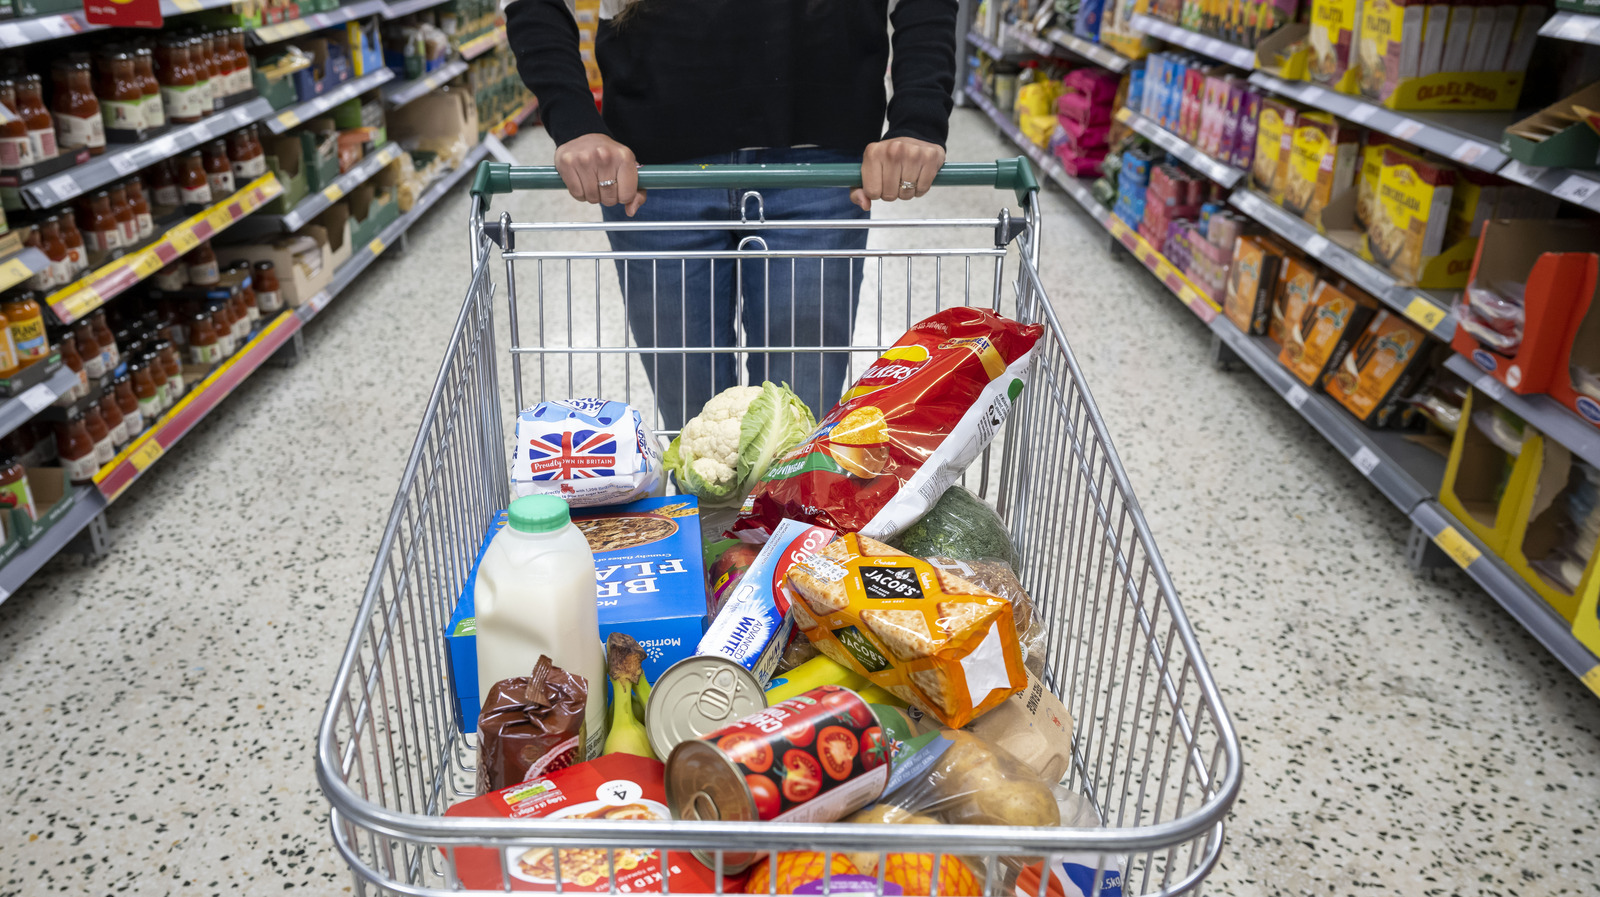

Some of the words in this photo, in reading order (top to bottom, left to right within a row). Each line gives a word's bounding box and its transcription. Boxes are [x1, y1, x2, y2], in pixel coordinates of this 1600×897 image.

[861, 363, 920, 381] ALKERS
[534, 460, 562, 471] Proudly
[595, 558, 688, 581] FLA
[597, 577, 660, 598] BR
[864, 569, 917, 597] JACOB'S
[637, 637, 682, 648] Morriso
[734, 619, 764, 660] ADVANCED
[840, 634, 888, 667] JACOB'S
[613, 790, 627, 801] 4
